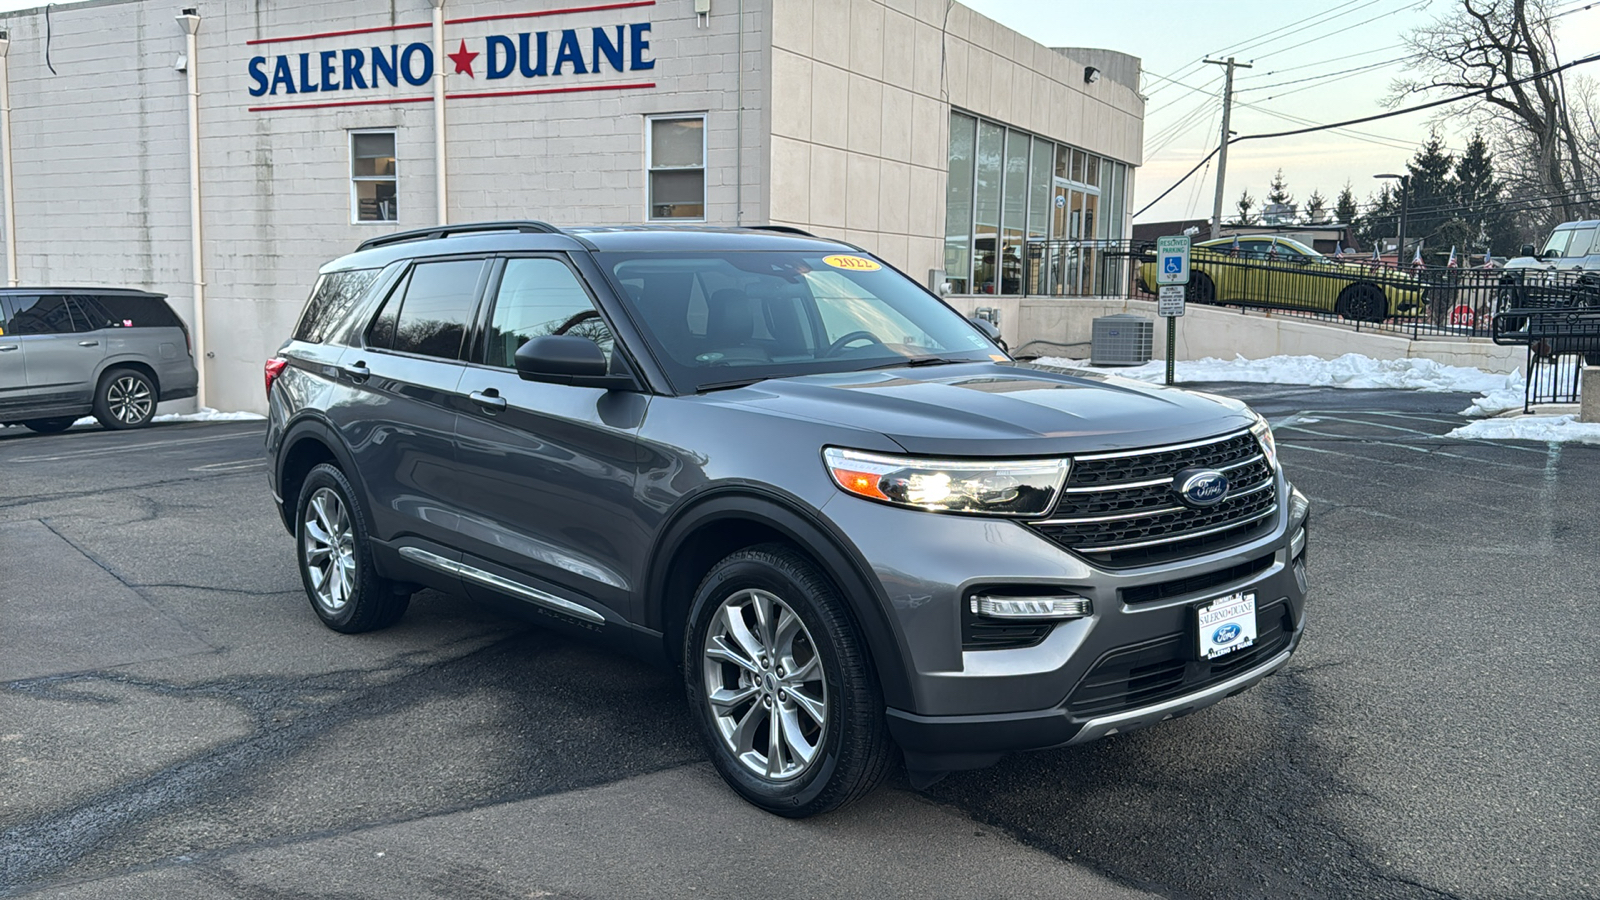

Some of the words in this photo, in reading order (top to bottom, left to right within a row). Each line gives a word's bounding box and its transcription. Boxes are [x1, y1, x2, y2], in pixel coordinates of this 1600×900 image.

[248, 42, 434, 97] SALERNO
[485, 22, 656, 80] DUANE
[834, 258, 872, 267] 2022
[1197, 479, 1222, 498] Ford
[1200, 608, 1228, 625] SALERNO
[1231, 602, 1253, 616] DUANE
[1217, 626, 1236, 642] Ford
